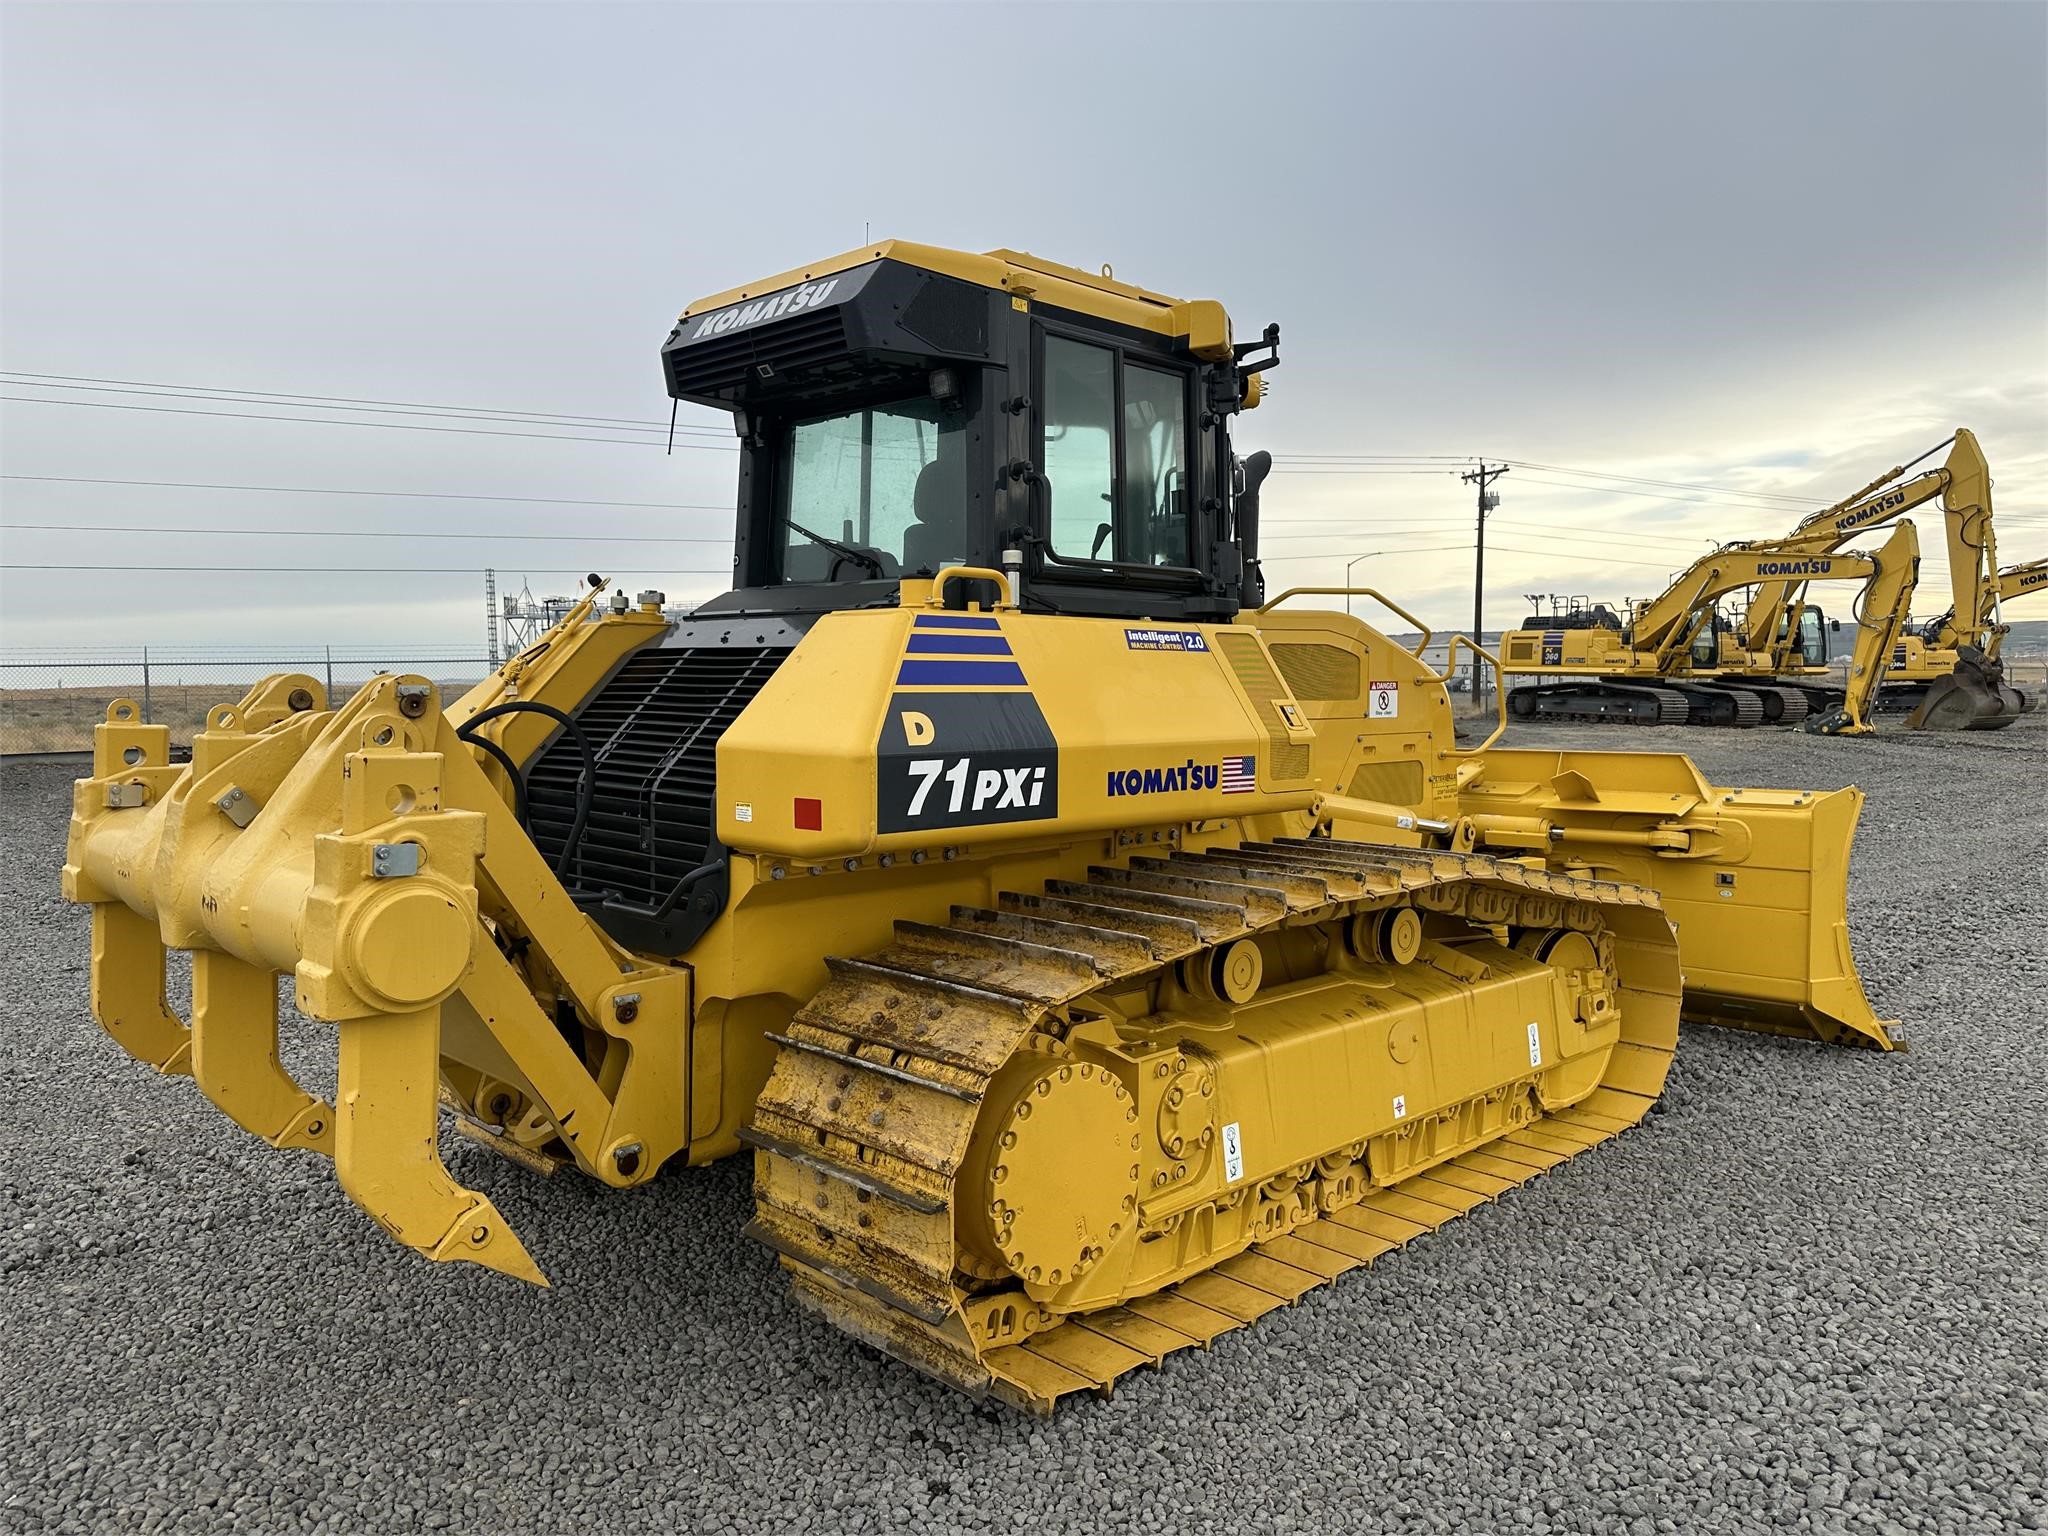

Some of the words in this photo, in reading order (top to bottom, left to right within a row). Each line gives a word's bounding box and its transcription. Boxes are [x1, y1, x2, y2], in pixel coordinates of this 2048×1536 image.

[692, 279, 839, 339] KOMATSU
[1835, 492, 1905, 530] KOMATSU
[1757, 557, 1831, 576] KOMATSU
[1130, 642, 1158, 650] MACHINE
[1185, 635, 1204, 649] 2.0
[1545, 653, 1559, 661] 360
[1376, 682, 1397, 690] DANGER
[901, 711, 936, 747] D
[1107, 759, 1219, 797] KOMATSU
